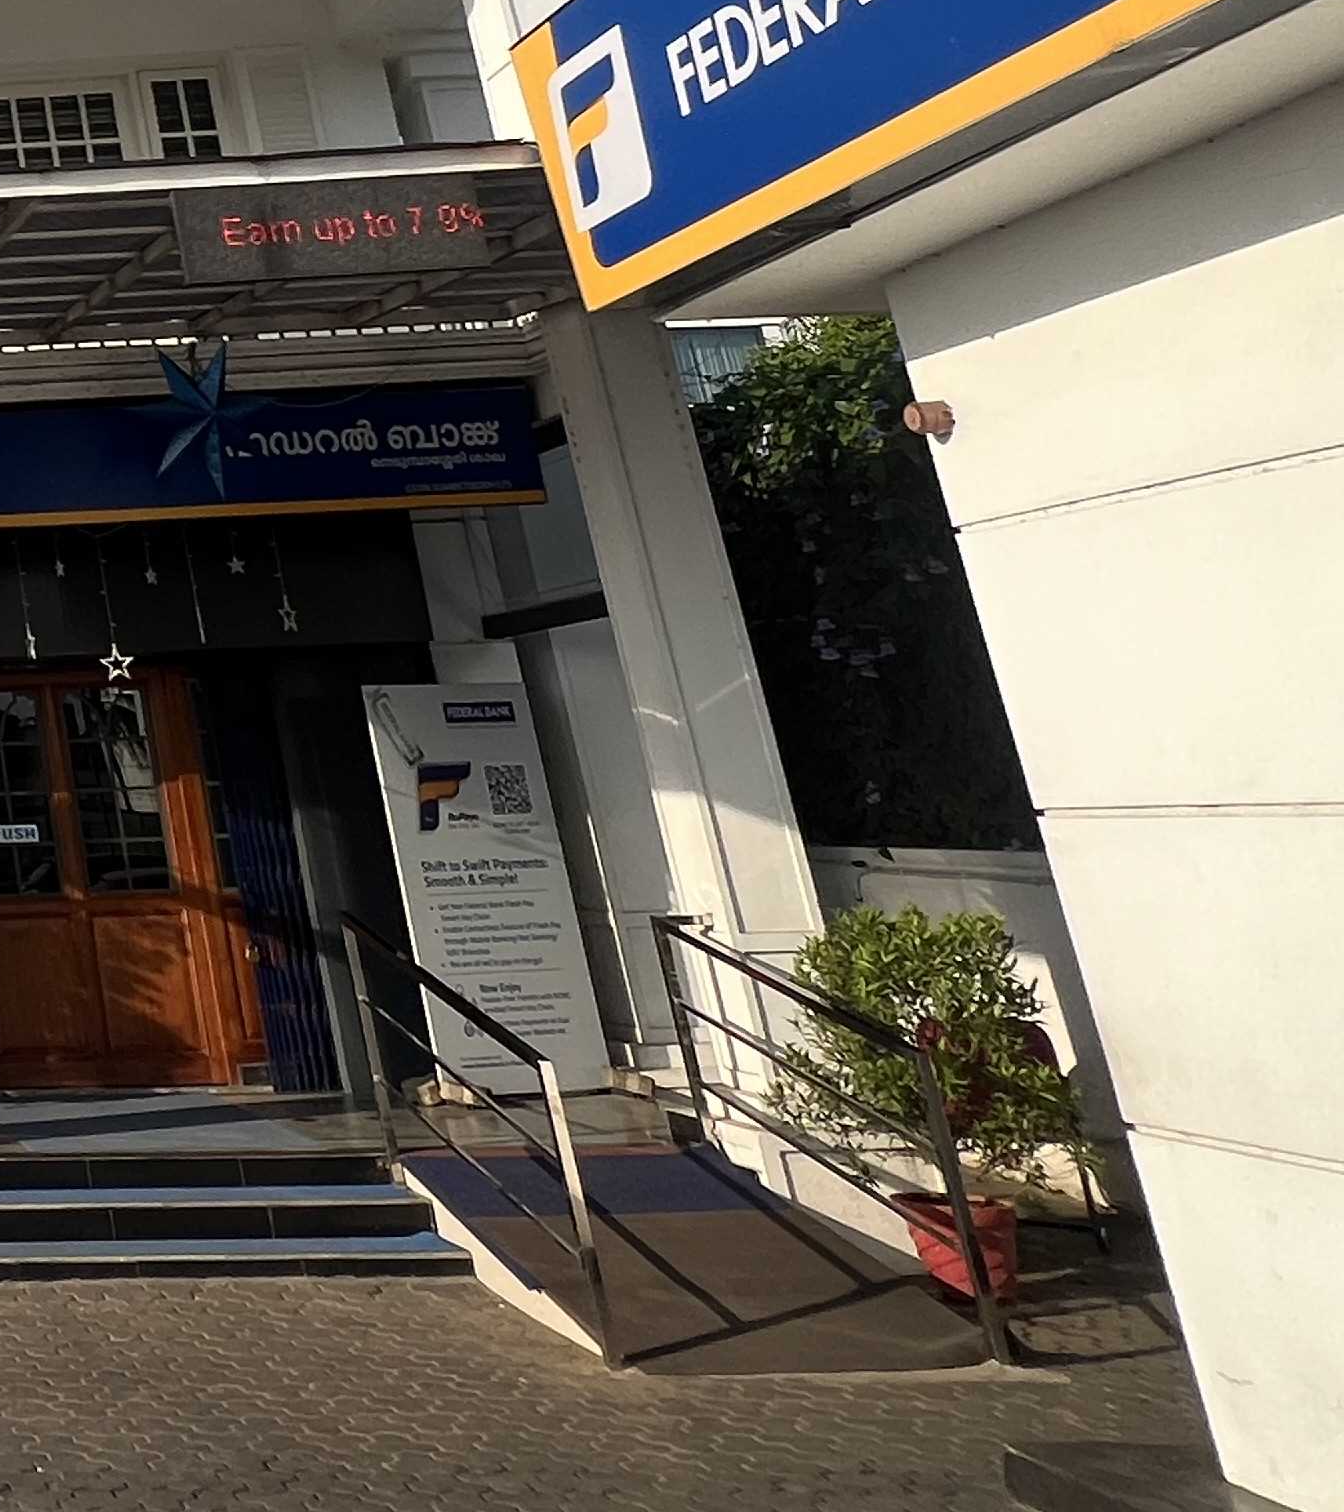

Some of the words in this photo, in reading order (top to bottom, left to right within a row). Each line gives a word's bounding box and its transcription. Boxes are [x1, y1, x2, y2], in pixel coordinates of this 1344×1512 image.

[314, 215, 355, 246] up
[362, 209, 397, 238] to
[387, 420, 500, 450] ബാങ്ക്
